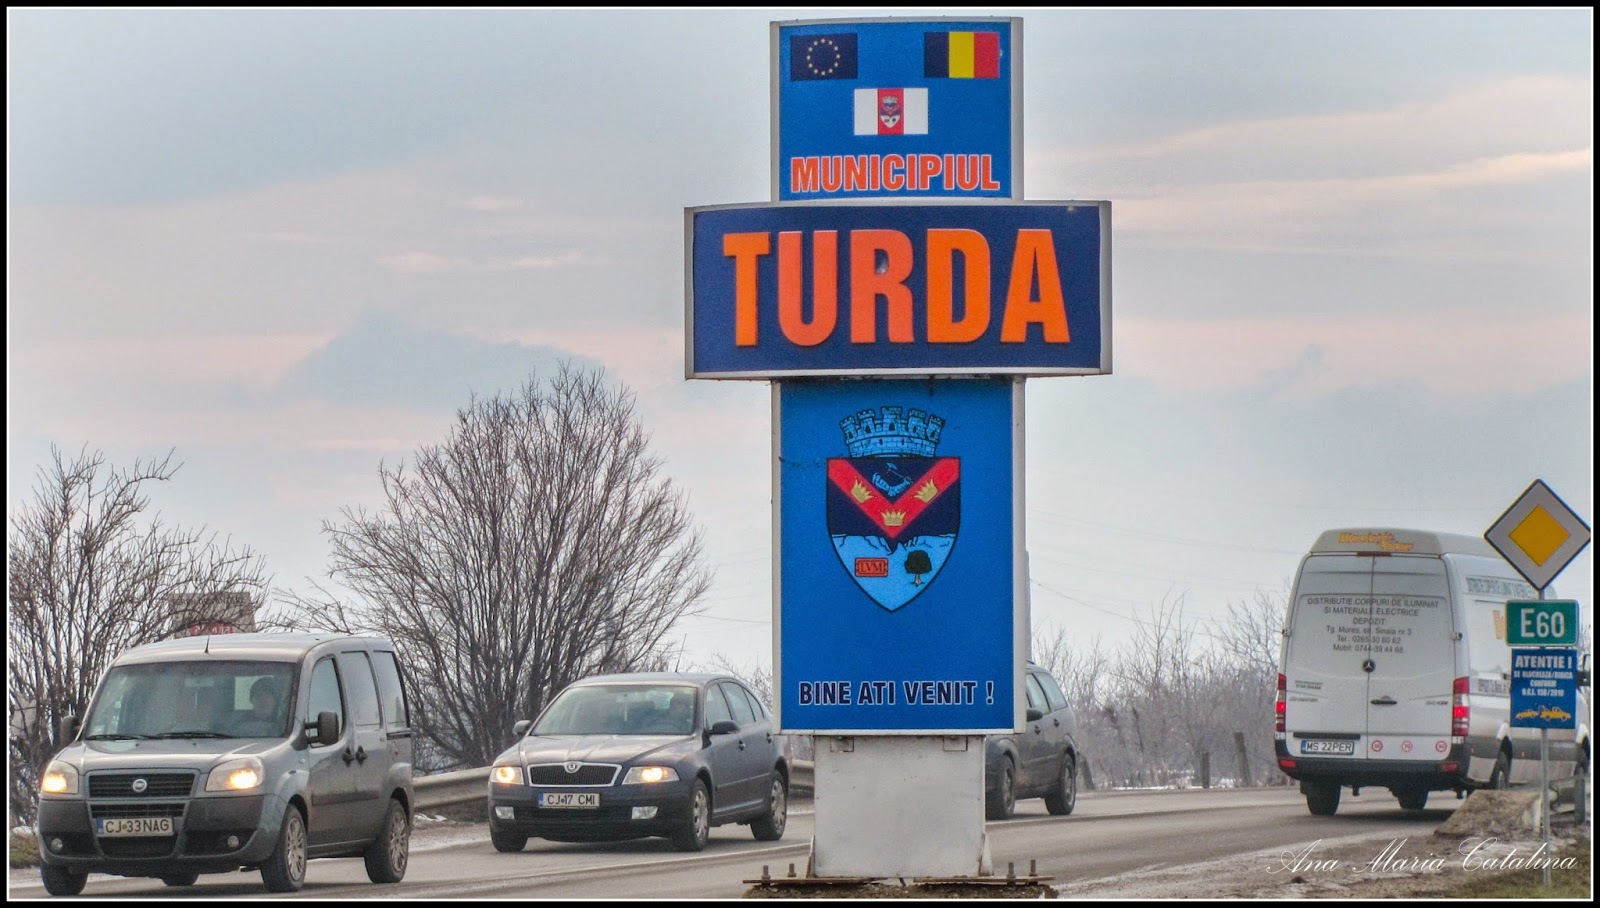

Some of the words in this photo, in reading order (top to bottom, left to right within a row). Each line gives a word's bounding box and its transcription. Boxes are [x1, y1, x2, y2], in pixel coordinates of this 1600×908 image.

[790, 153, 1000, 193] MUNICIPIUL
[722, 228, 1071, 347] TURDA
[860, 560, 885, 574] LVM
[1307, 598, 1354, 606] DISTRIBUTIE
[1355, 598, 1390, 606] CORPURI
[1391, 599, 1402, 607] DE
[1404, 600, 1439, 608] ILUMINAT
[1333, 607, 1374, 615] MATERIALE
[1376, 608, 1419, 616] ELECTRICE
[1520, 607, 1565, 638] E60
[1515, 655, 1565, 669] ATENTIE
[1567, 656, 1573, 669] !
[799, 681, 852, 706] BINE
[857, 681, 896, 706] ATI
[904, 681, 977, 706] VENIT
[986, 681, 994, 705] !
[1306, 742, 1319, 751] MS
[1321, 742, 1353, 752] 22PER
[548, 795, 561, 805] CJ
[578, 795, 595, 805] CMI
